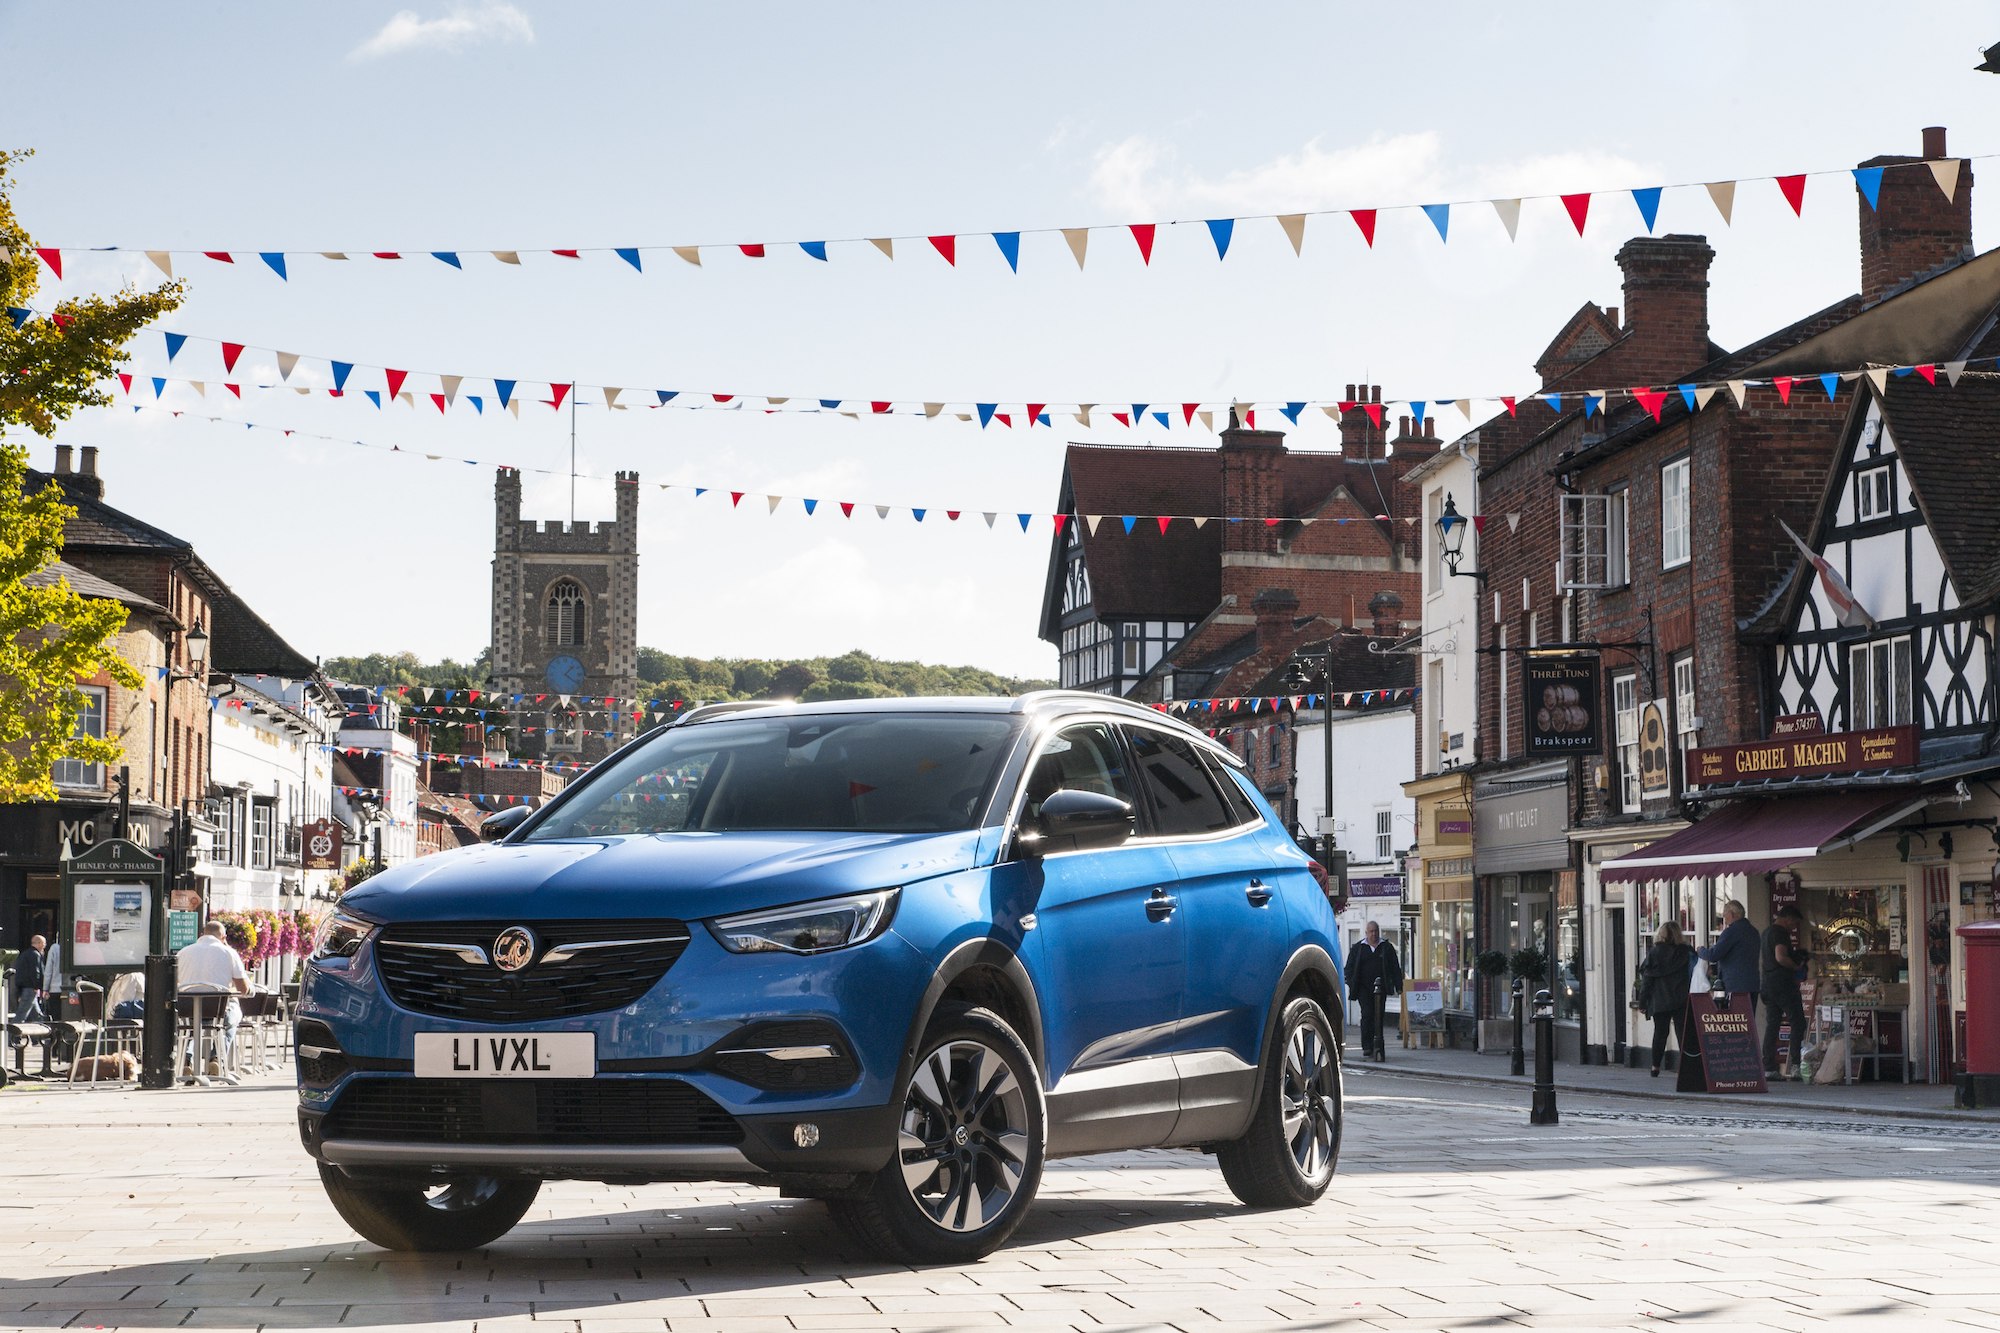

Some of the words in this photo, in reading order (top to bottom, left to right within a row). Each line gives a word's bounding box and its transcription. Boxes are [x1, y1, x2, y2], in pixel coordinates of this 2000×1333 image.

[1531, 670, 1562, 679] THREE
[1564, 669, 1590, 678] TUNS
[1775, 720, 1794, 734] Phone
[1795, 716, 1817, 732] 574377
[1535, 737, 1593, 746] Brakspear
[1861, 733, 1896, 748] Gamedealers
[1735, 747, 1788, 773] GABRIEL
[1793, 741, 1847, 768] MACHIN
[1870, 748, 1894, 761] Smokers
[1498, 811, 1514, 830] MINT
[1515, 808, 1538, 828] VELVET
[1701, 1013, 1748, 1022] GABRIEL
[1850, 1008, 1870, 1018] Cheese
[1704, 1023, 1749, 1033] MACHIN
[489, 1038, 551, 1071] VXL
